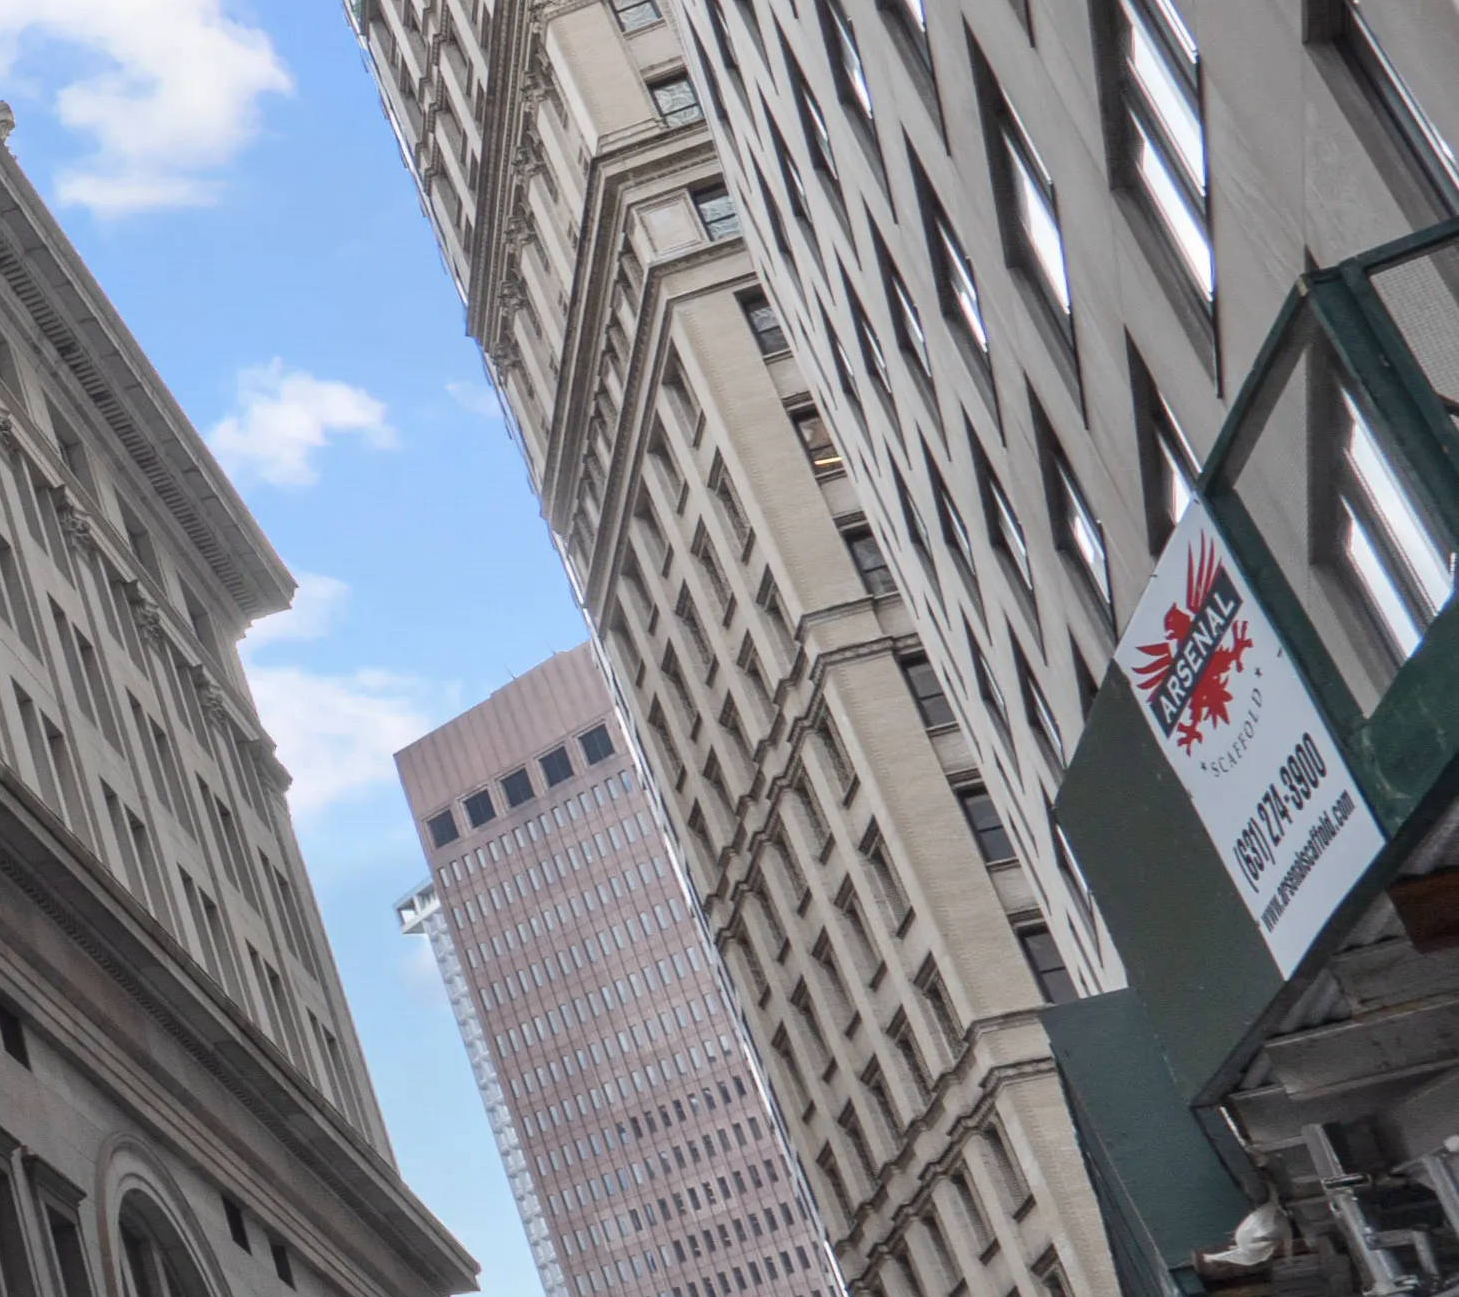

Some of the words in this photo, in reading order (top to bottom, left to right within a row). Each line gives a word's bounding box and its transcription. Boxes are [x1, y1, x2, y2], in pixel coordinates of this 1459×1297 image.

[1160, 592, 1234, 724] ARSENAL
[1211, 688, 1263, 778] SCAFFOLD
[1233, 817, 1276, 893] (631)
[1257, 732, 1327, 847] 274-3900
[1261, 789, 1356, 933] www.arsenalscaffold.com
